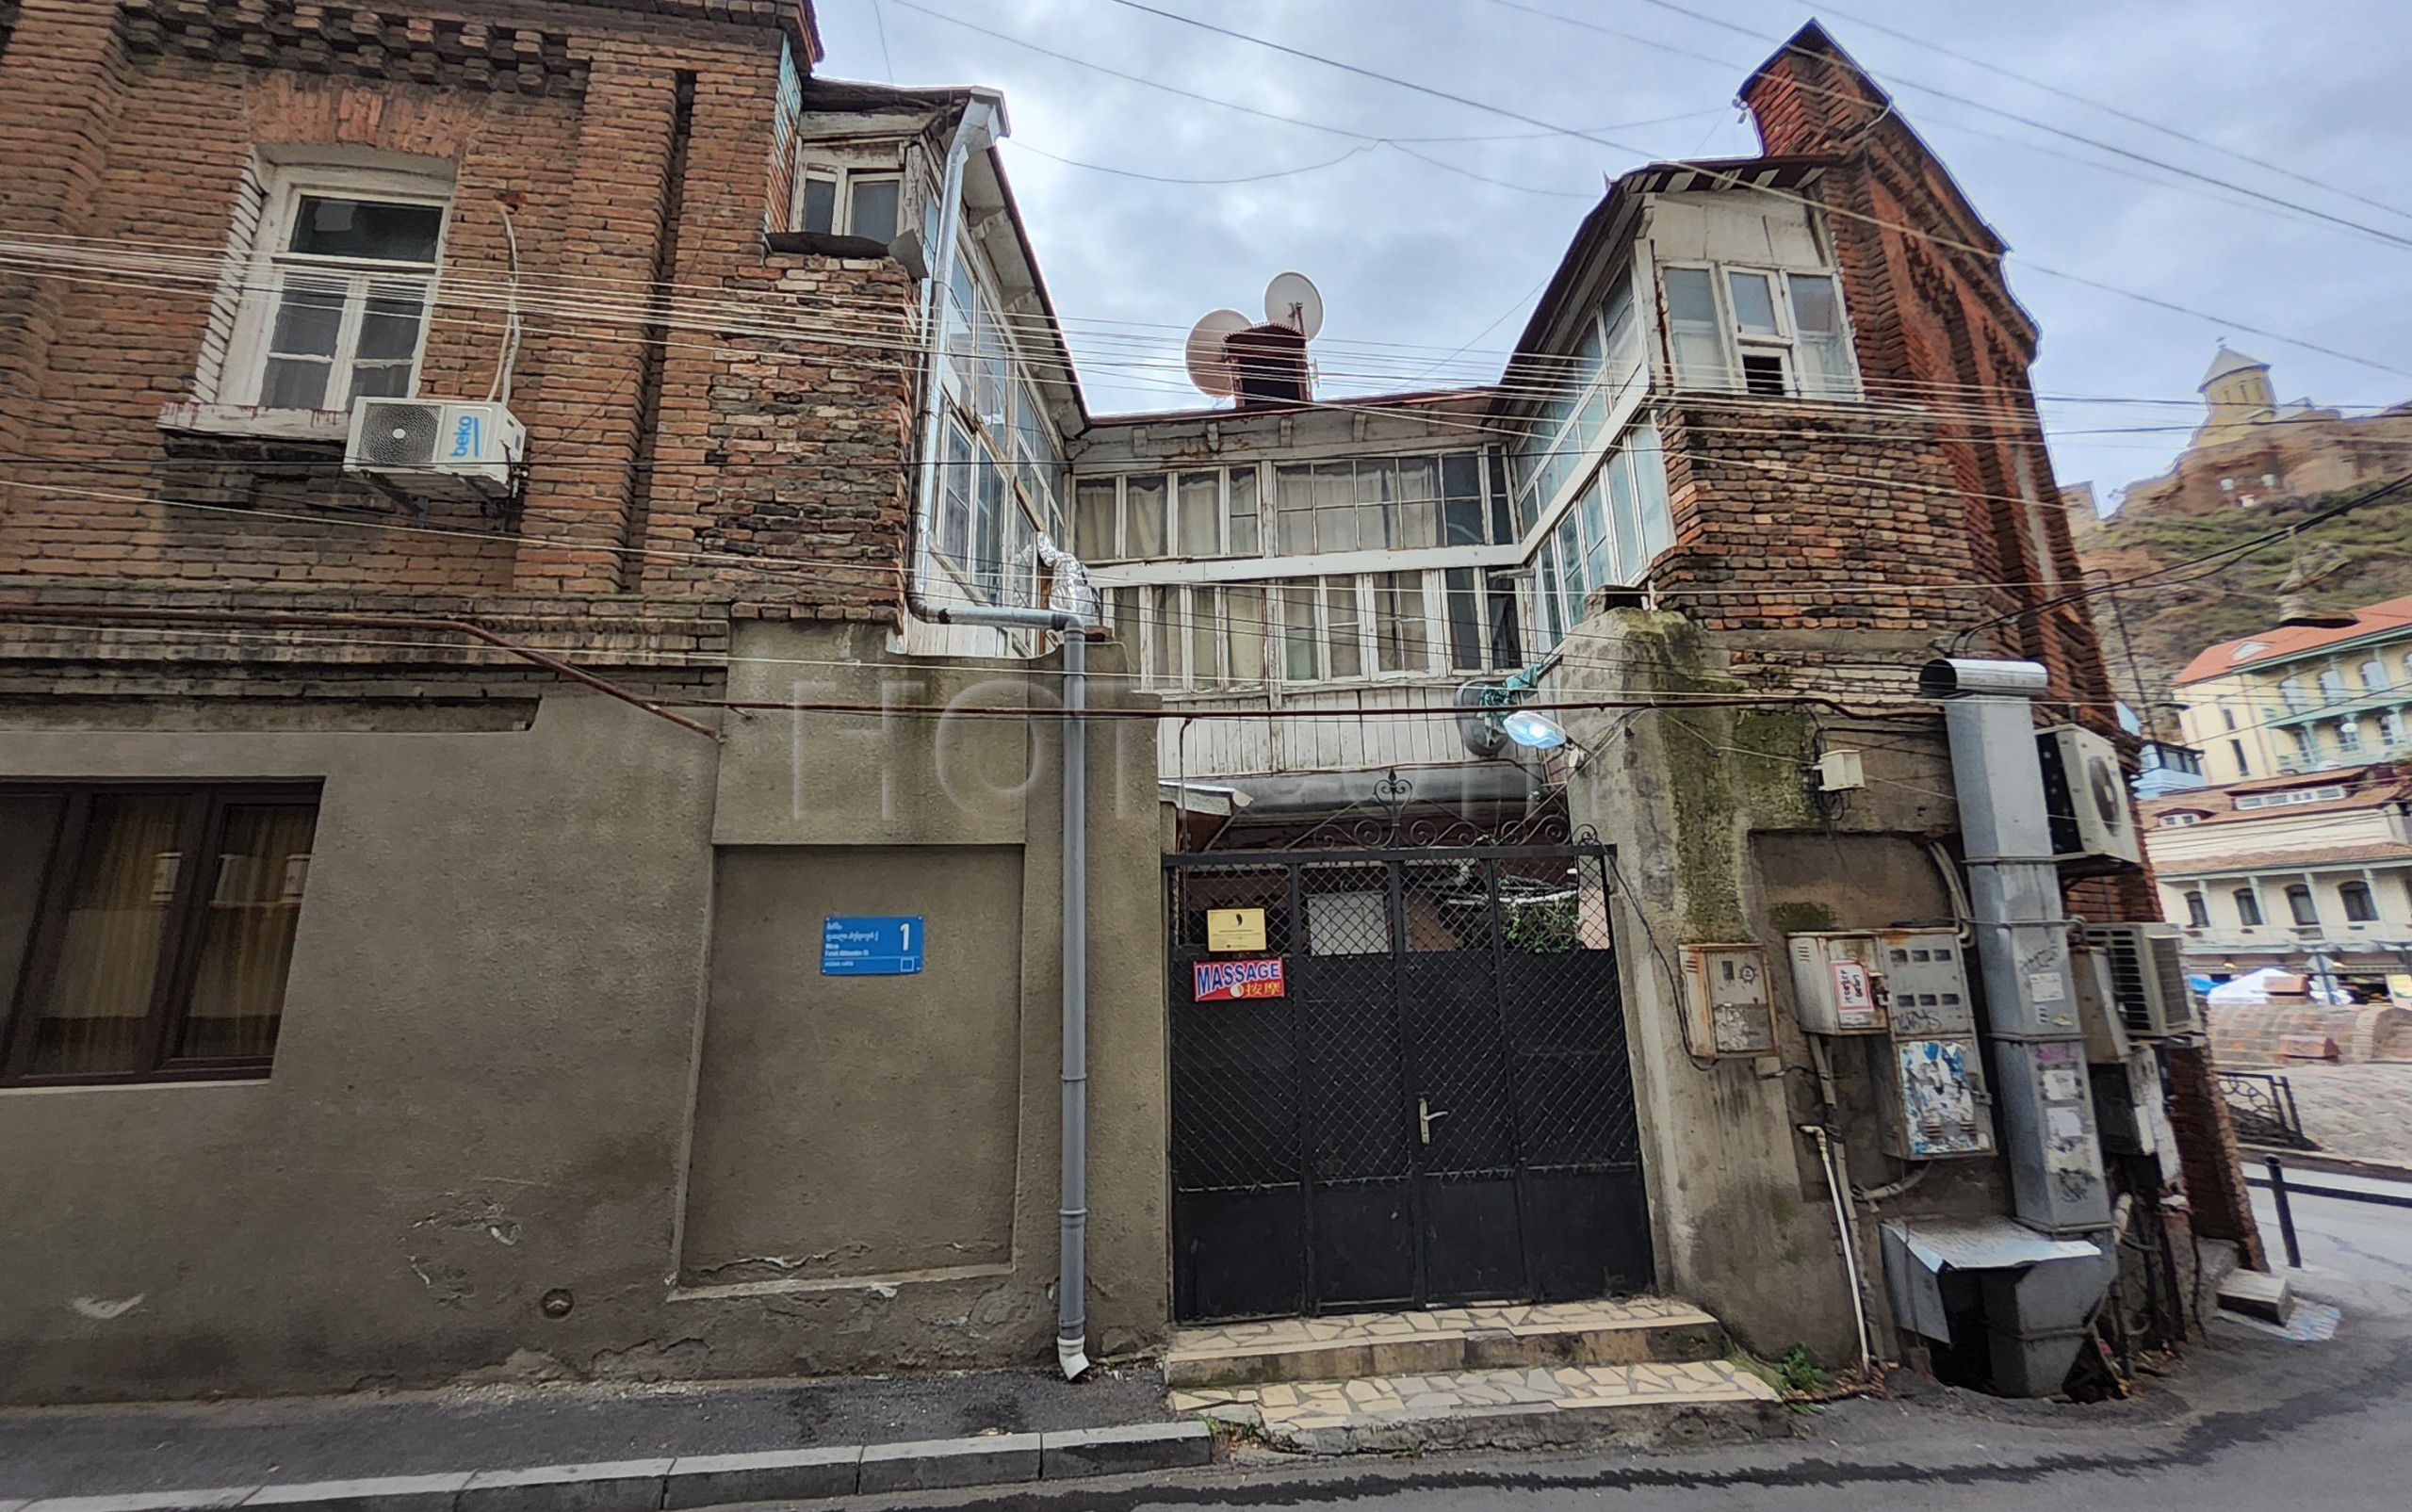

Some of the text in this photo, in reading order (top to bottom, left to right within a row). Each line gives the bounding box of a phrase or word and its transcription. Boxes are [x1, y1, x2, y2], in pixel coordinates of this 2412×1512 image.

[449, 415, 473, 458] beko
[899, 923, 910, 951] 1
[1196, 961, 1280, 997] MASSAGE
[1245, 982, 1281, 996] 按摩
